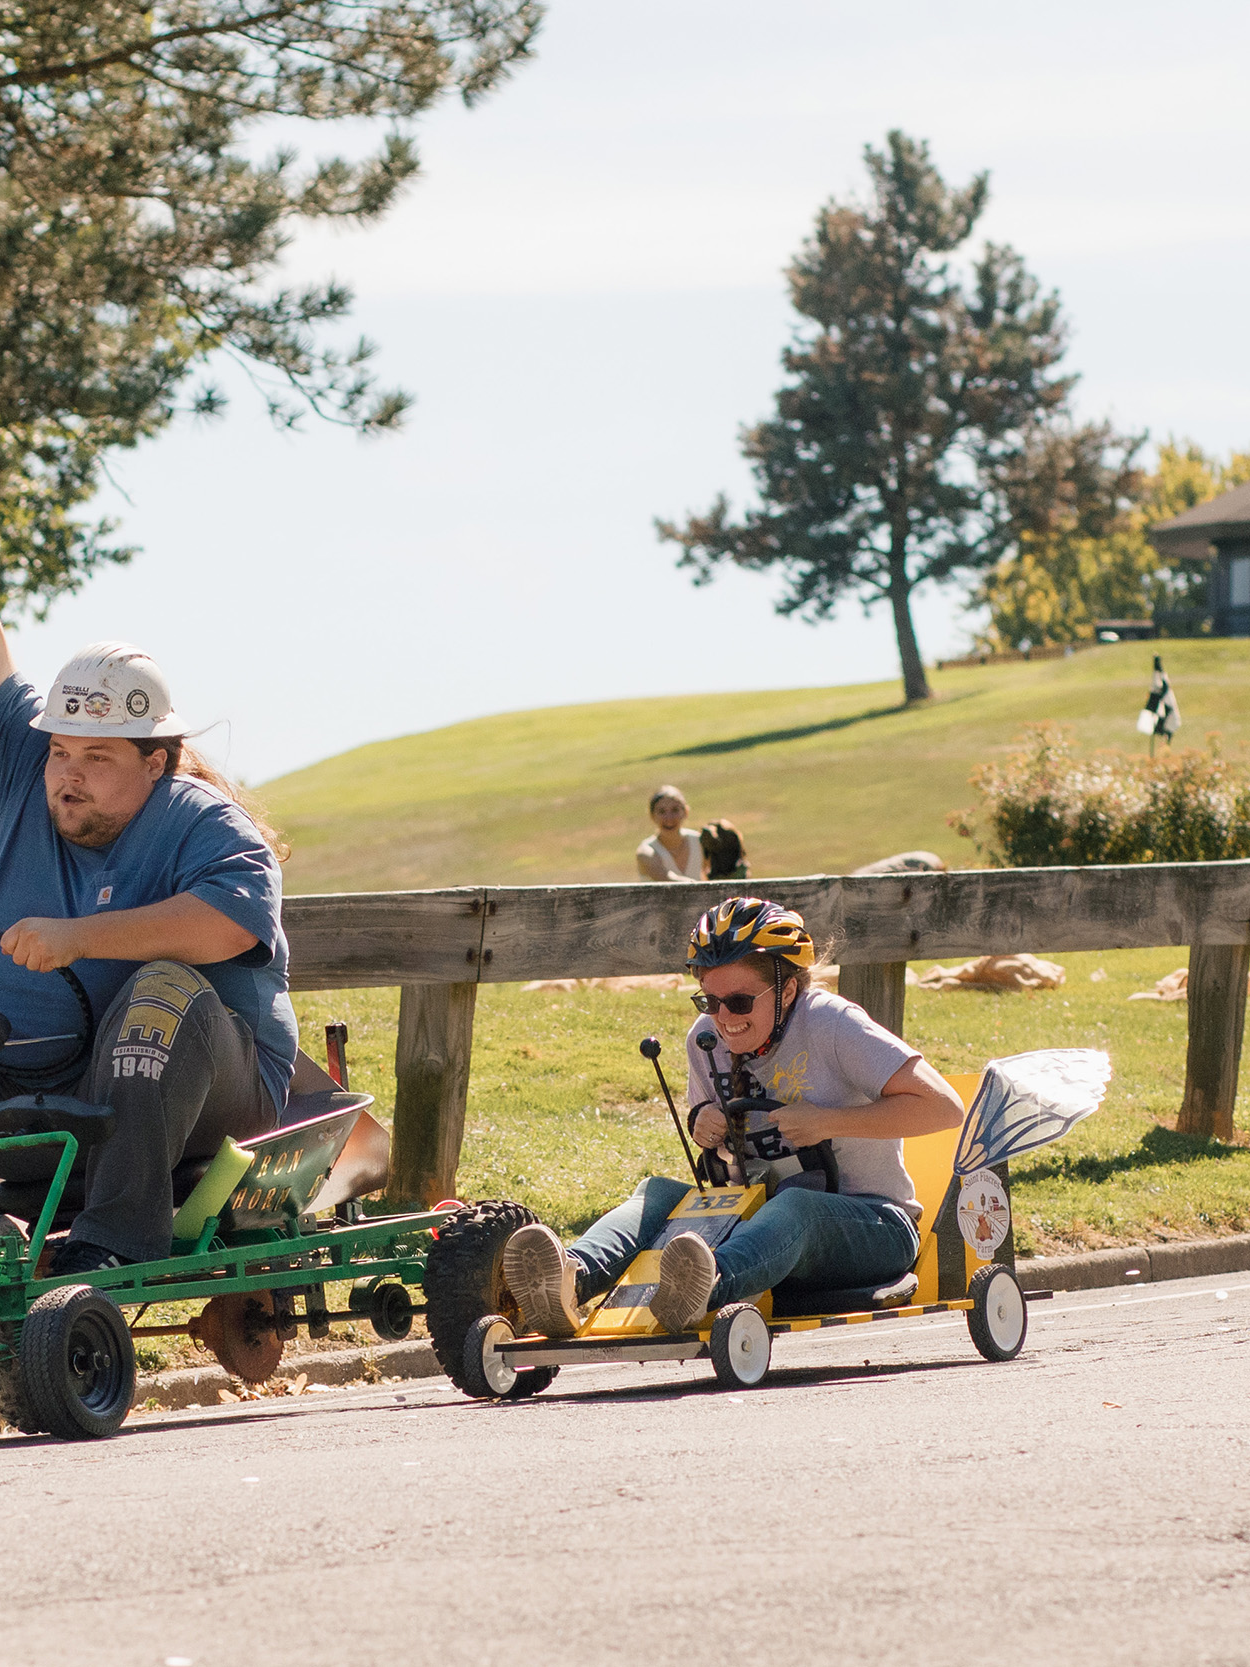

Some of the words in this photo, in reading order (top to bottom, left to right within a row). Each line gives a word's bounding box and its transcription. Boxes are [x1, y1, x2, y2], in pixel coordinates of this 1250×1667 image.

[63, 684, 90, 692] RICCELLI
[115, 1047, 156, 1056] ESTABLISHED
[157, 1051, 166, 1060] IN
[112, 1056, 165, 1081] 1946
[685, 1193, 744, 1212] BE
